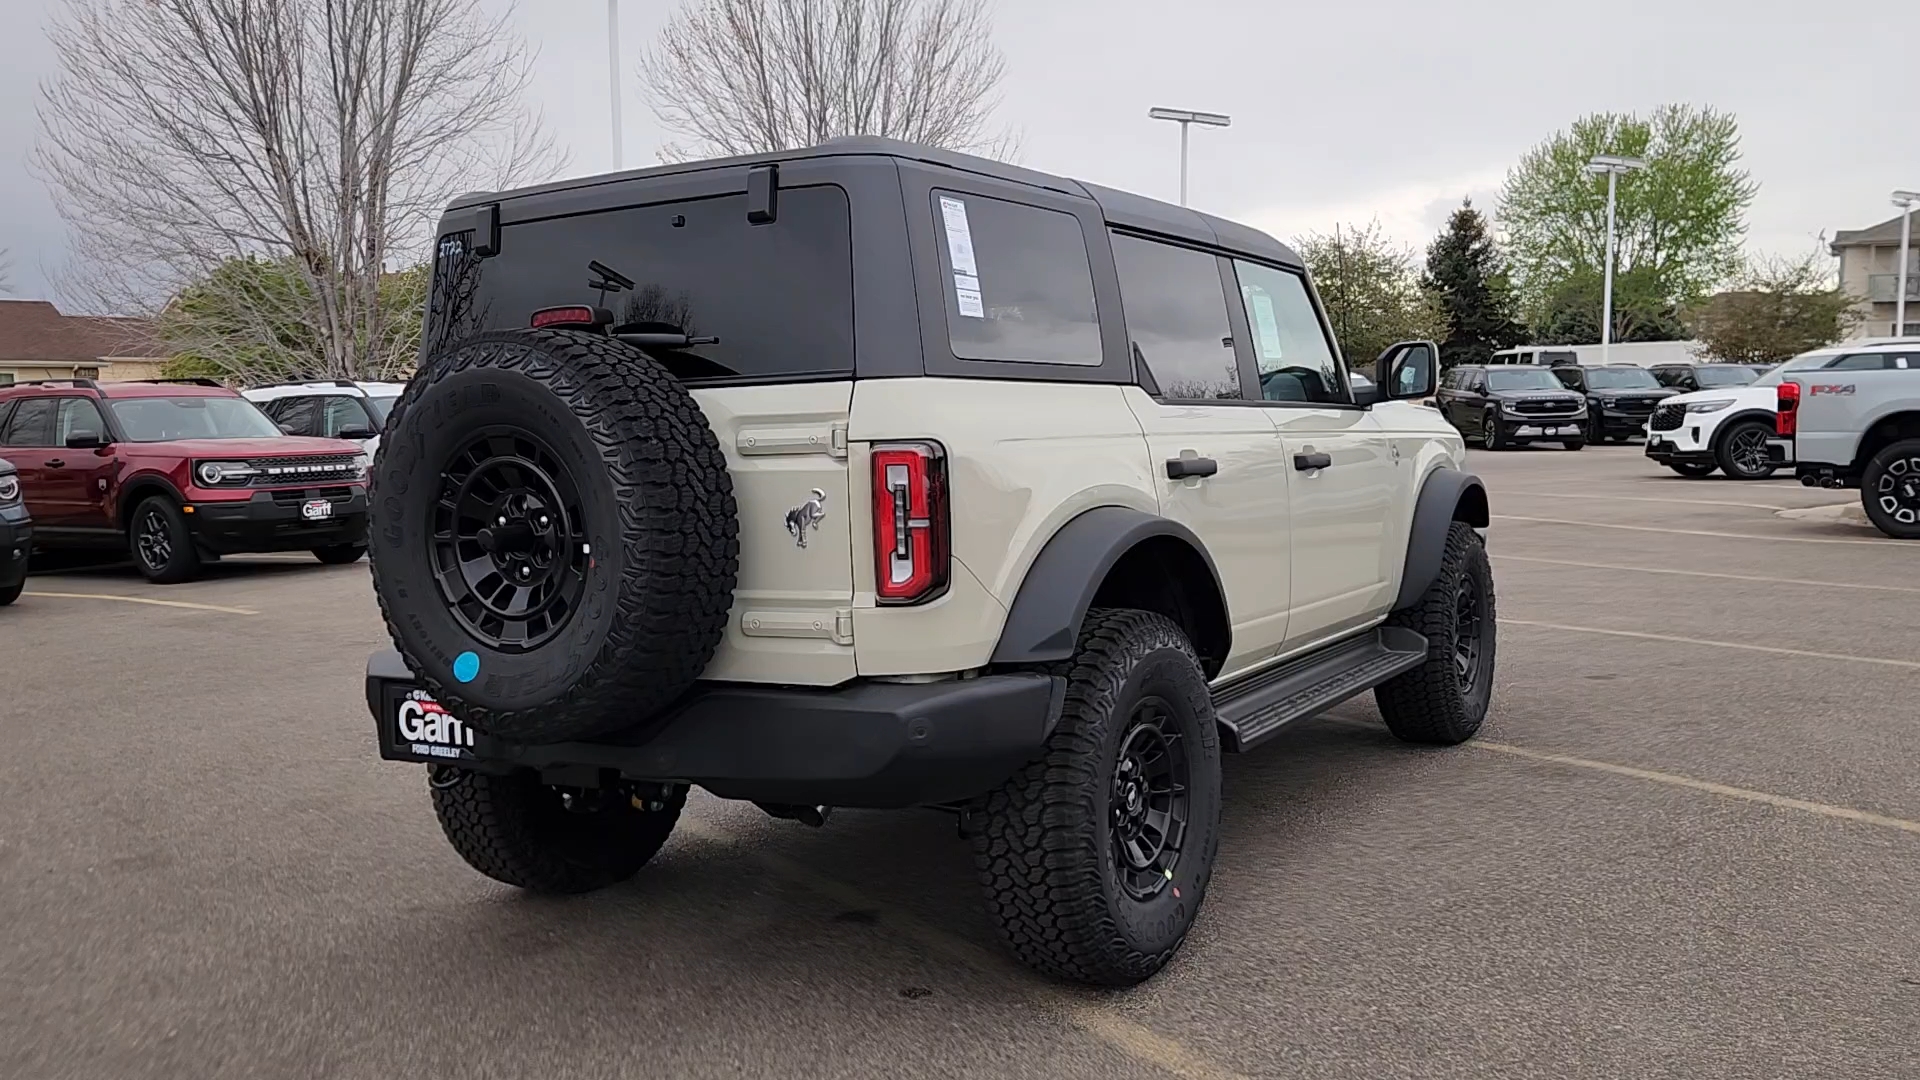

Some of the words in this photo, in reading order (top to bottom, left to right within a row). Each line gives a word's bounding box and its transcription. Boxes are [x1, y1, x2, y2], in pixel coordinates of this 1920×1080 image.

[1809, 384, 1856, 396] FX4
[268, 464, 346, 475] BRONCO
[302, 502, 331, 517] Garff
[412, 743, 430, 755] FORD
[430, 745, 461, 759] GREELEY
